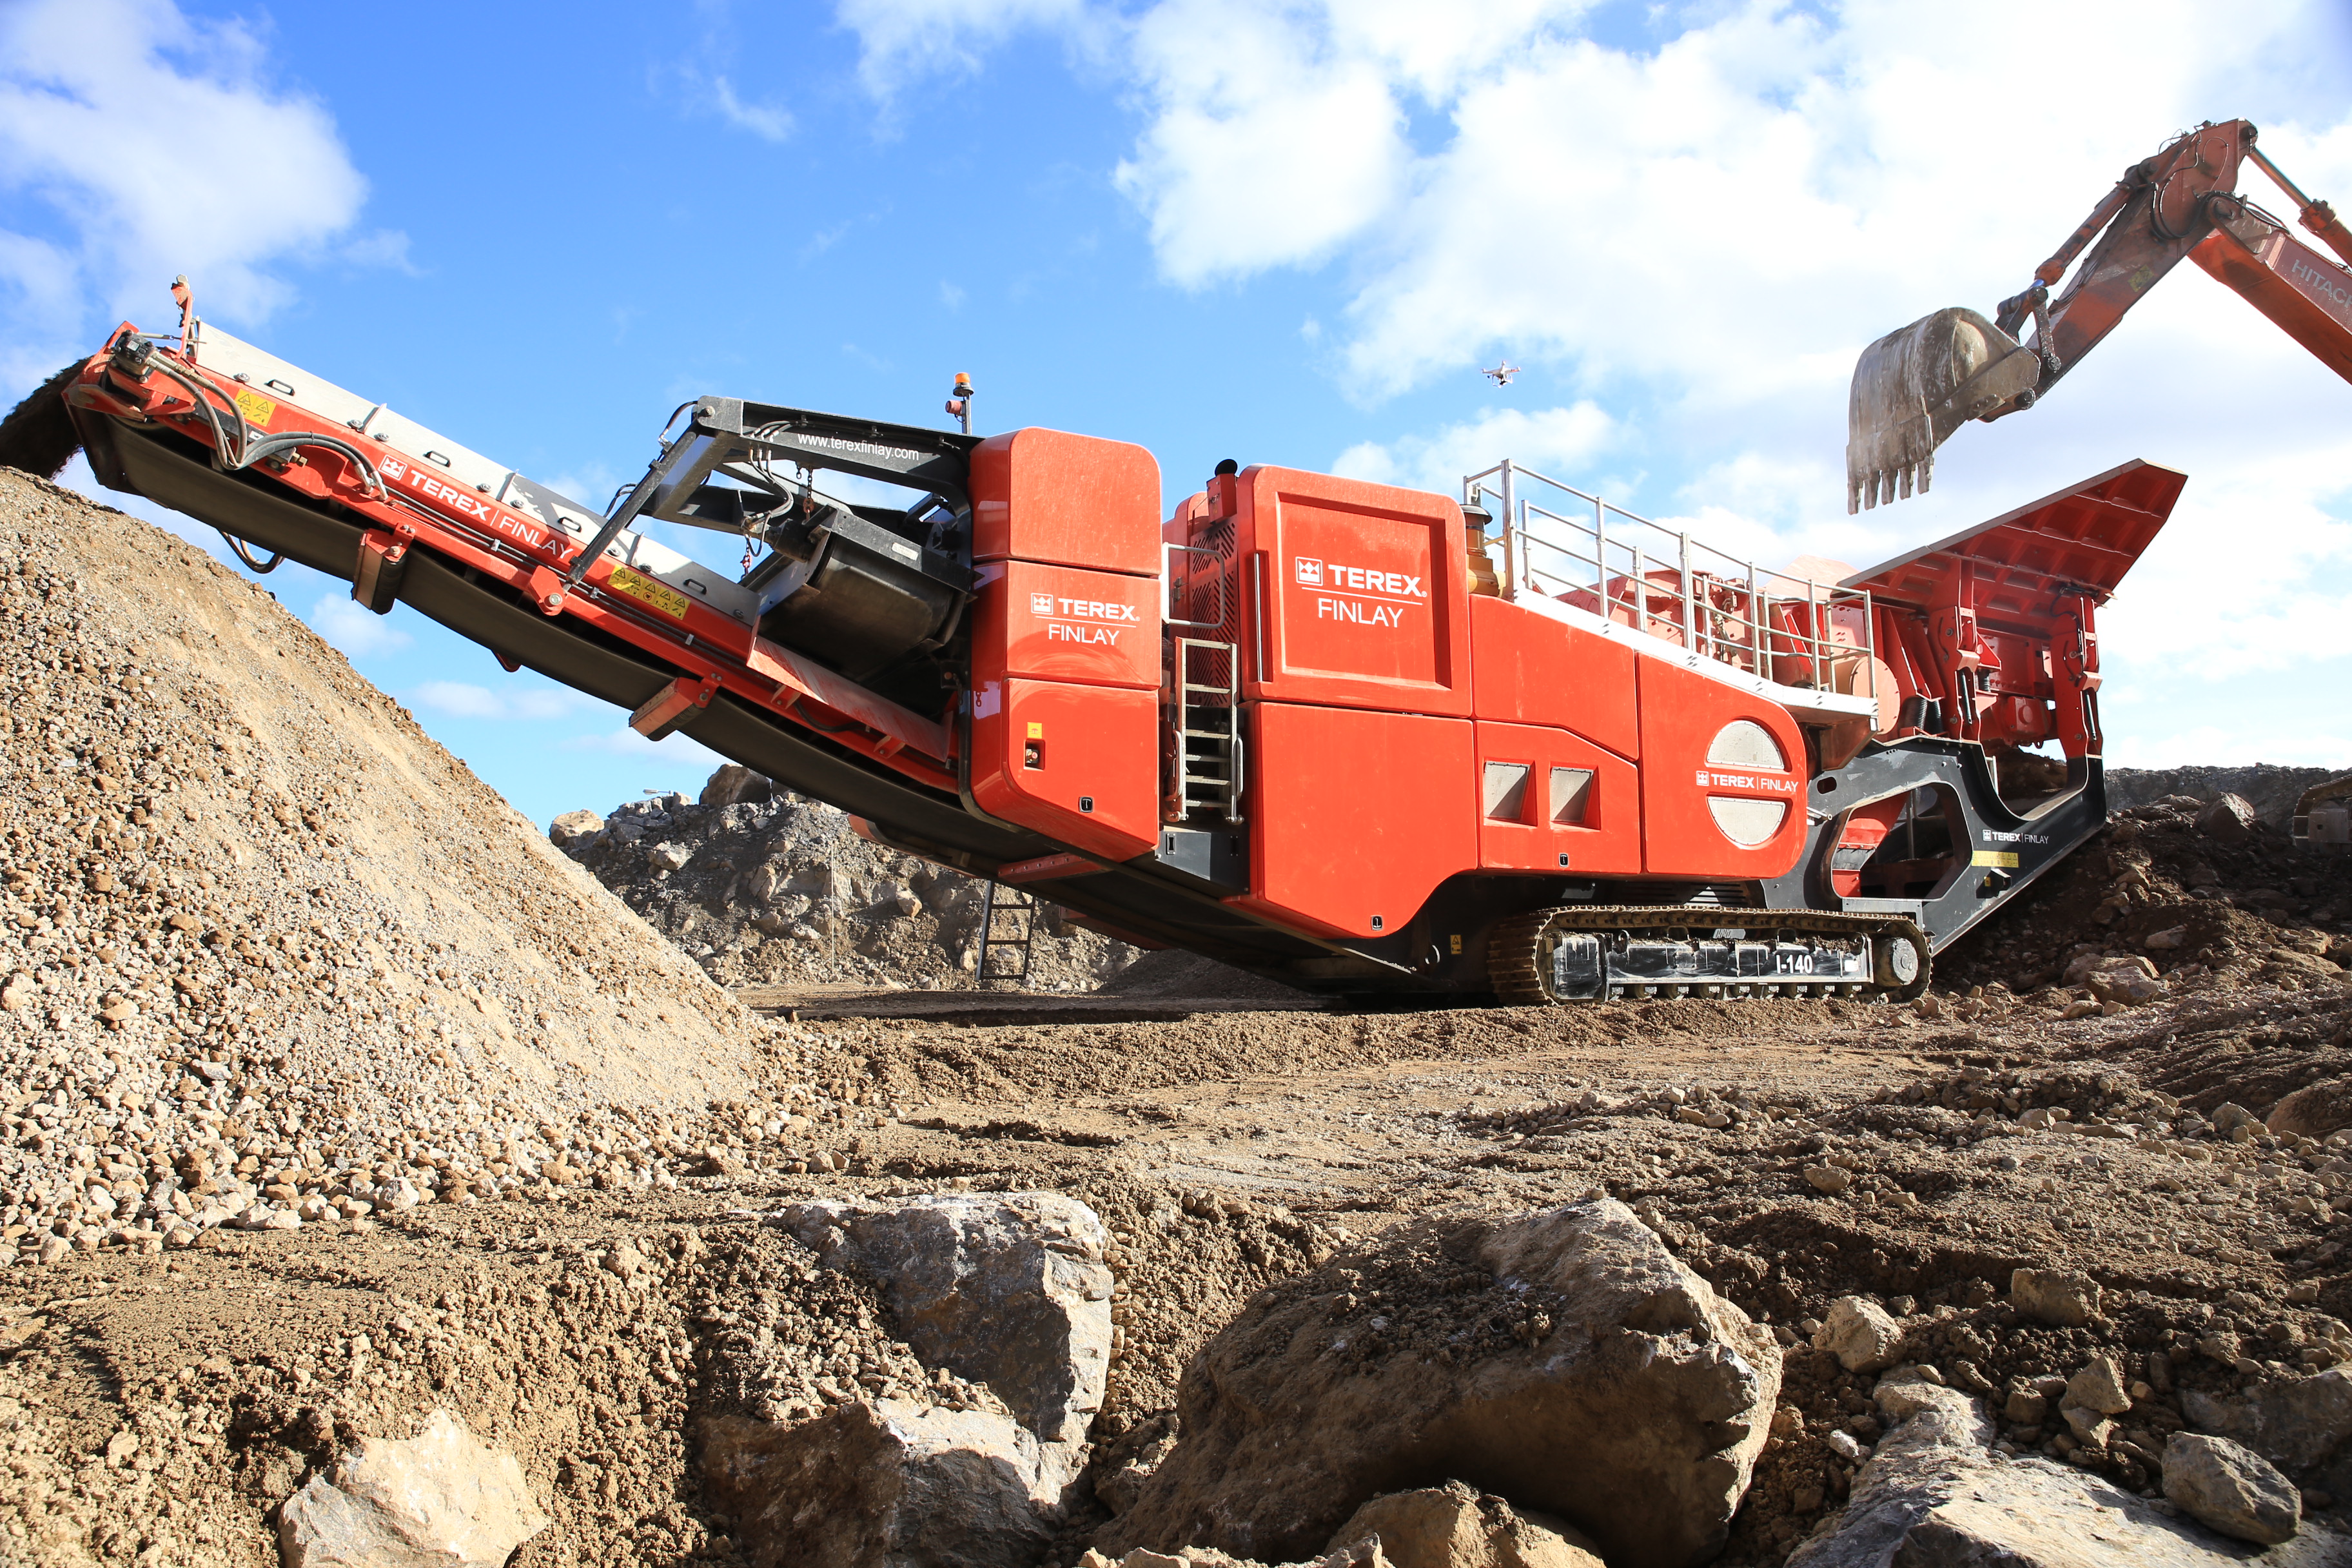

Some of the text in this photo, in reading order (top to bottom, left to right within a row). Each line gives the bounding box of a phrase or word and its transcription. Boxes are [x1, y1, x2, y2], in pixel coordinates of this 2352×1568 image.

[797, 433, 919, 460] www.terexfinlay.com
[410, 469, 573, 560] TEREX FINLAY
[1318, 597, 1404, 628] FINLAY
[1048, 623, 1120, 645] FINLAY
[1710, 774, 1799, 792] TEREX FINLAY
[1992, 831, 2049, 844] TEREX FINLAY
[1776, 954, 1813, 974] I-140
